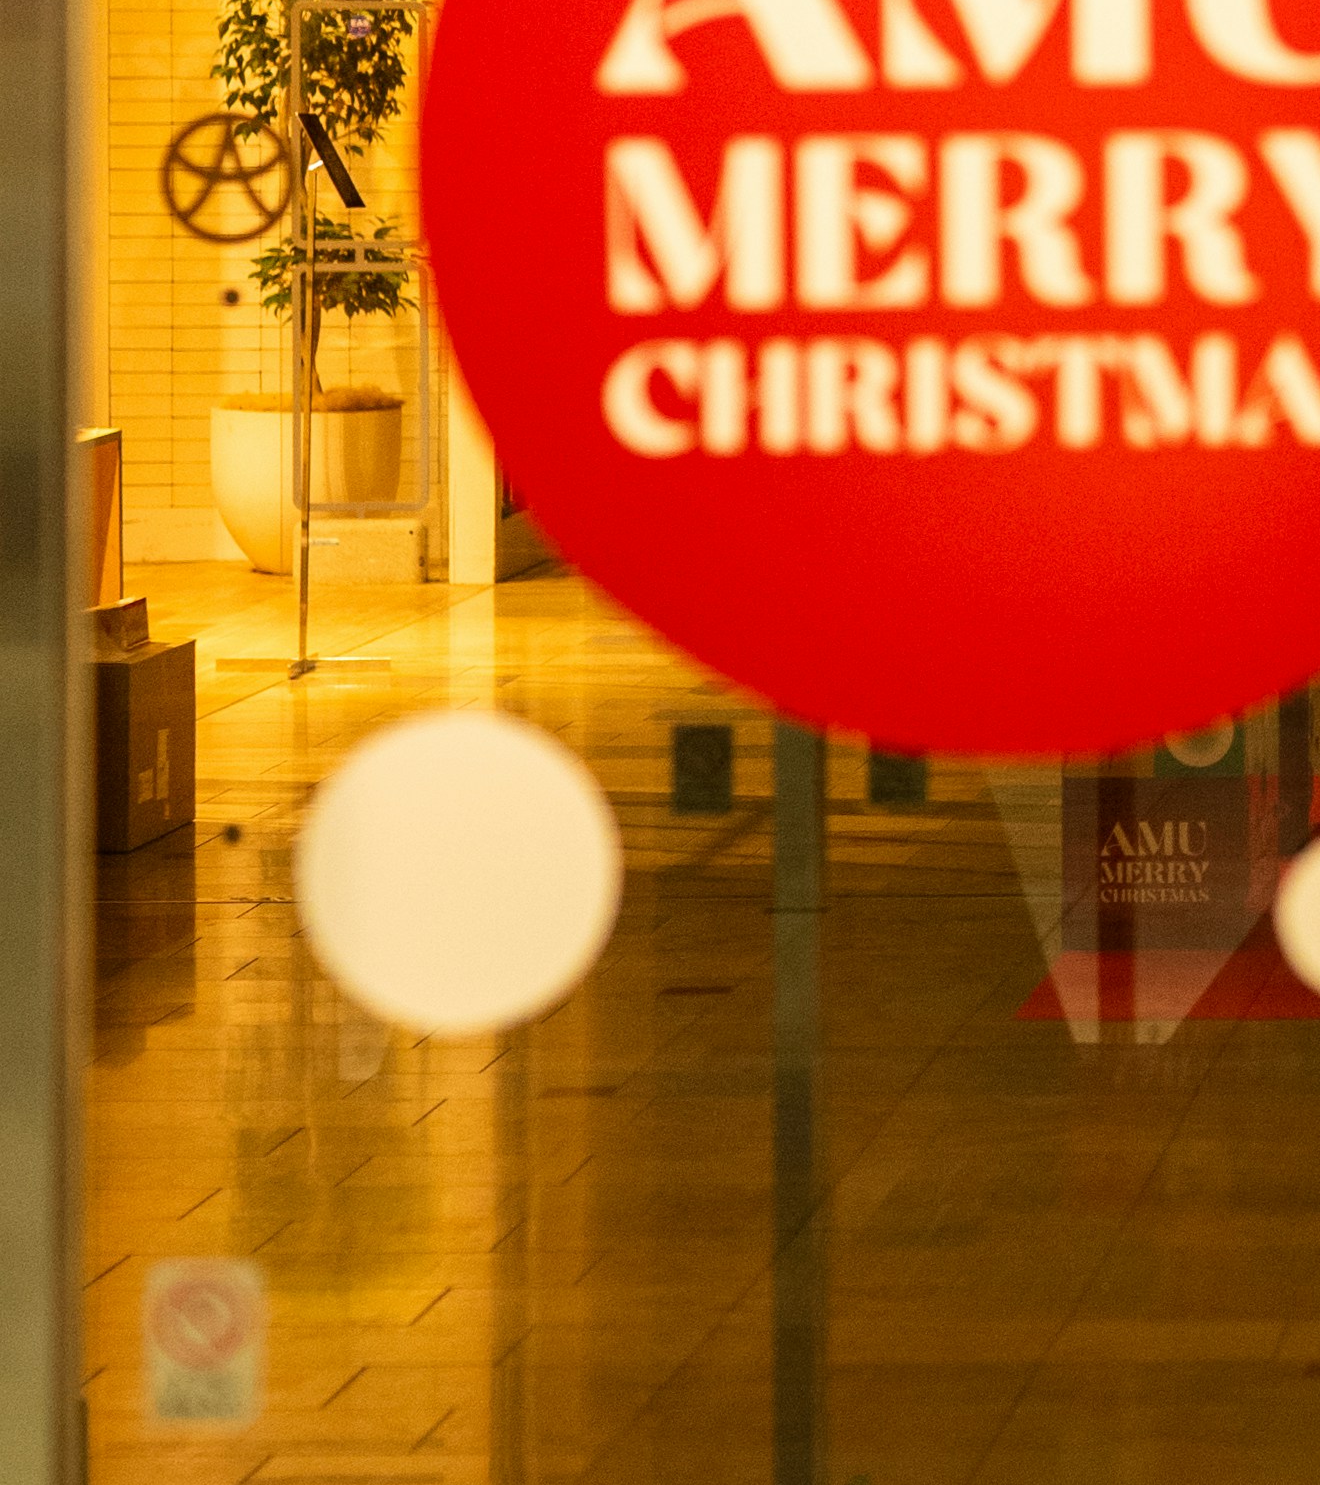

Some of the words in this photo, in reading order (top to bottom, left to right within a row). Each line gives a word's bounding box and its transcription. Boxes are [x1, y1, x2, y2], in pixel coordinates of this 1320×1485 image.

[1102, 821, 1206, 856] AMU
[1102, 862, 1209, 884] MERRY
[1102, 888, 1209, 903] CHRISTMAS
